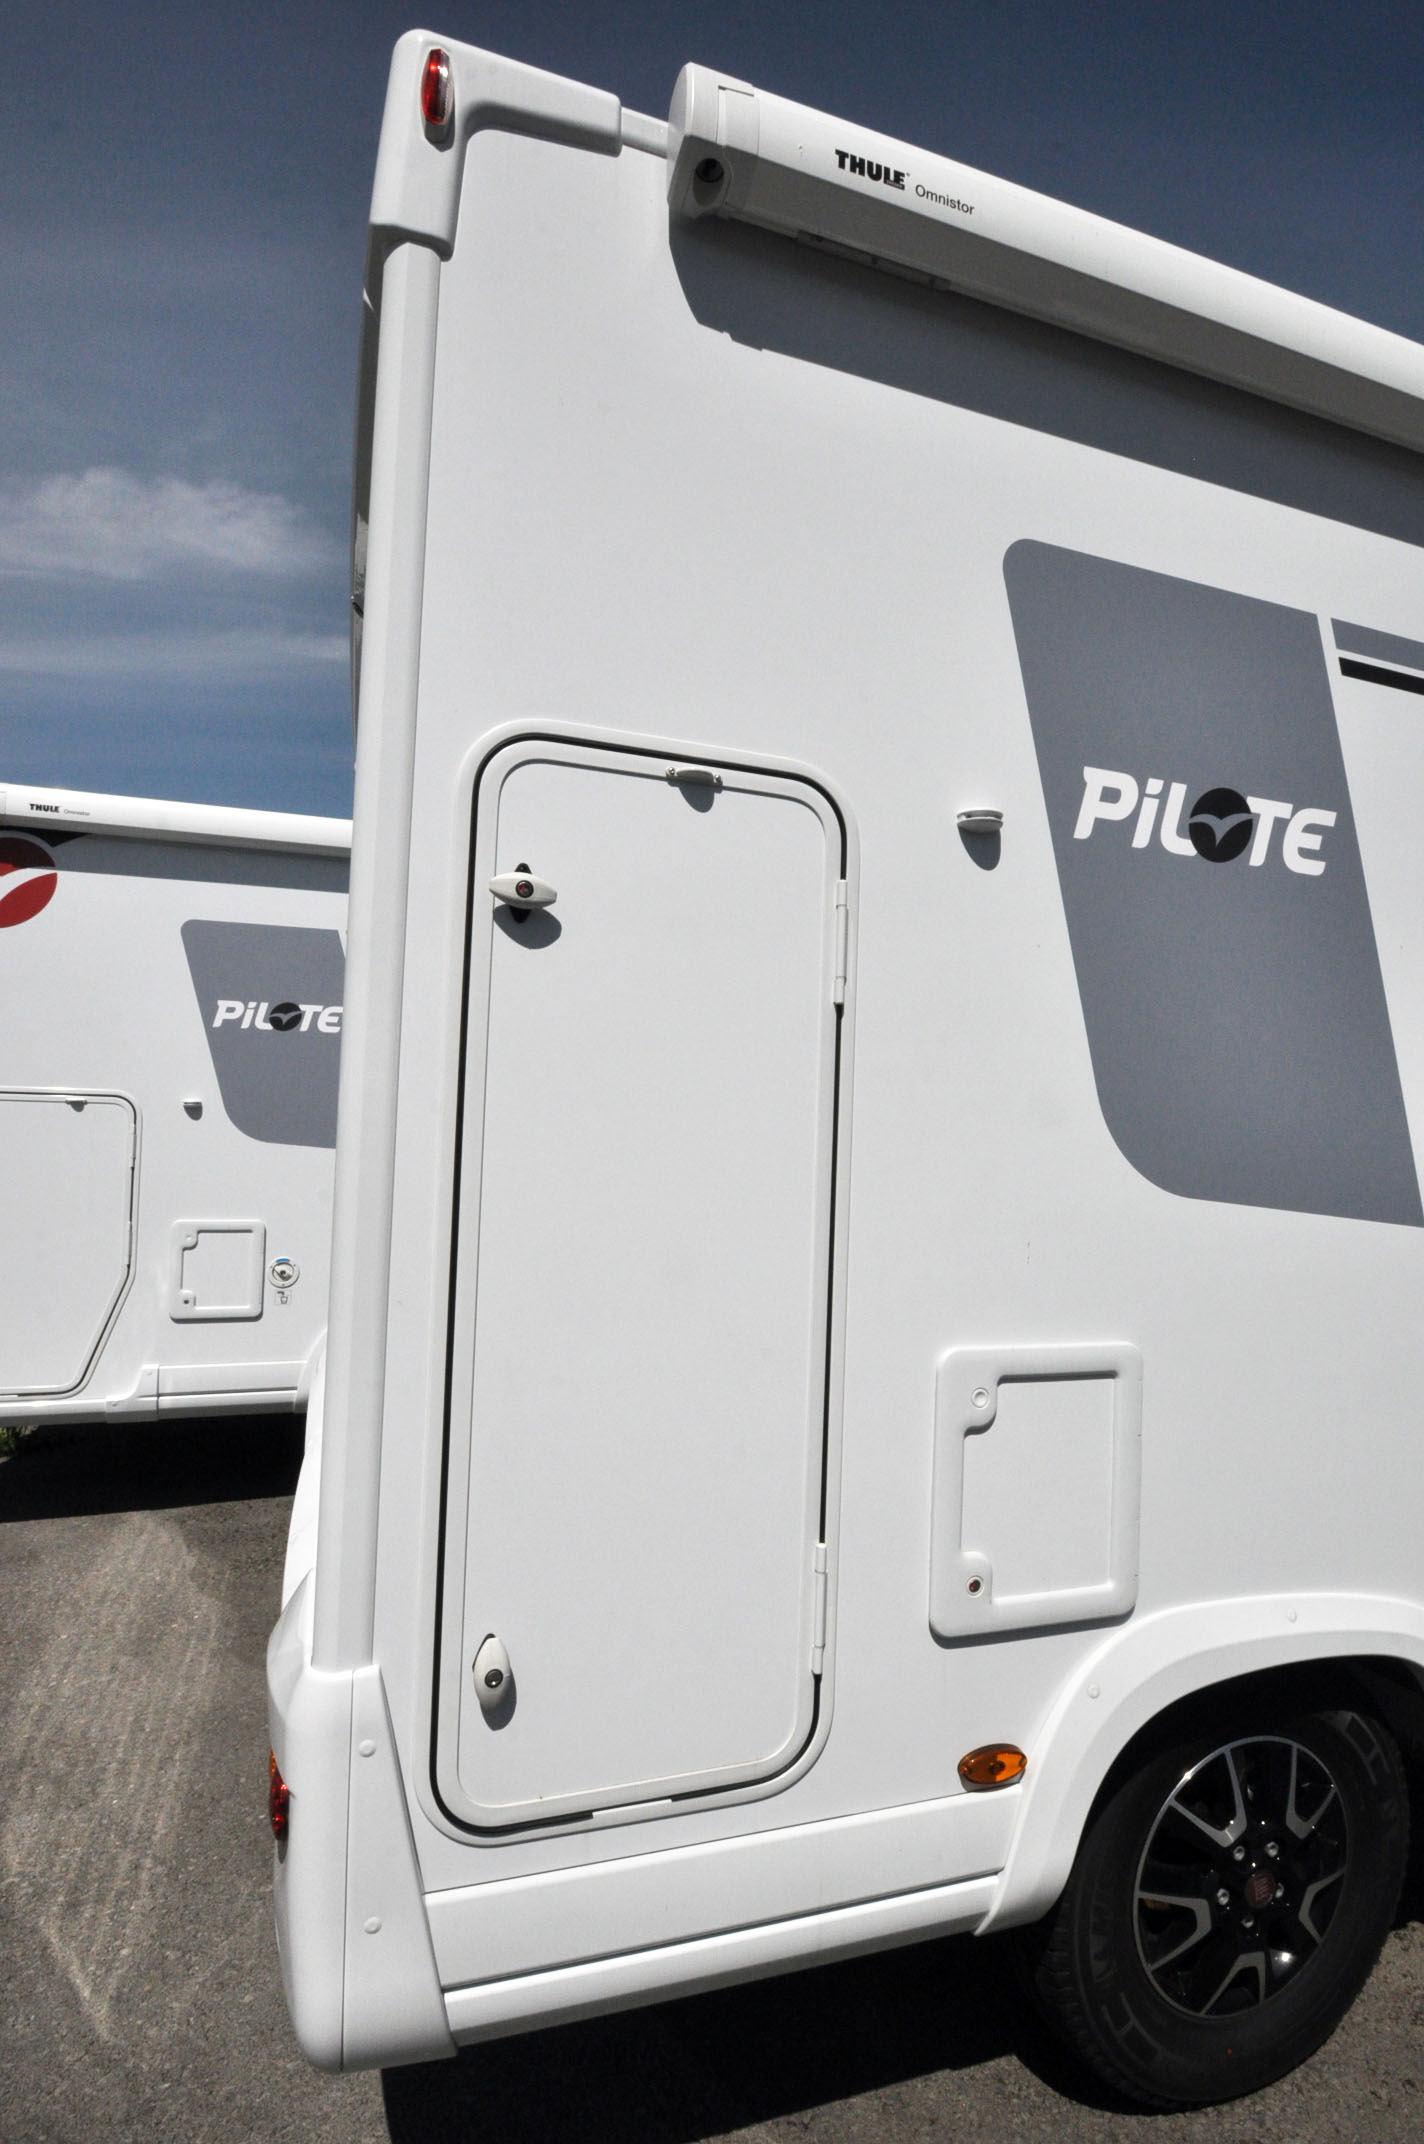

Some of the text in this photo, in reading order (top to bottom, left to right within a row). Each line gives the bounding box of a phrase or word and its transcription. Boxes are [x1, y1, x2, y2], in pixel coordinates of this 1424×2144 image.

[835, 149, 975, 215] THULE Omnistor
[29, 803, 60, 814] THULE
